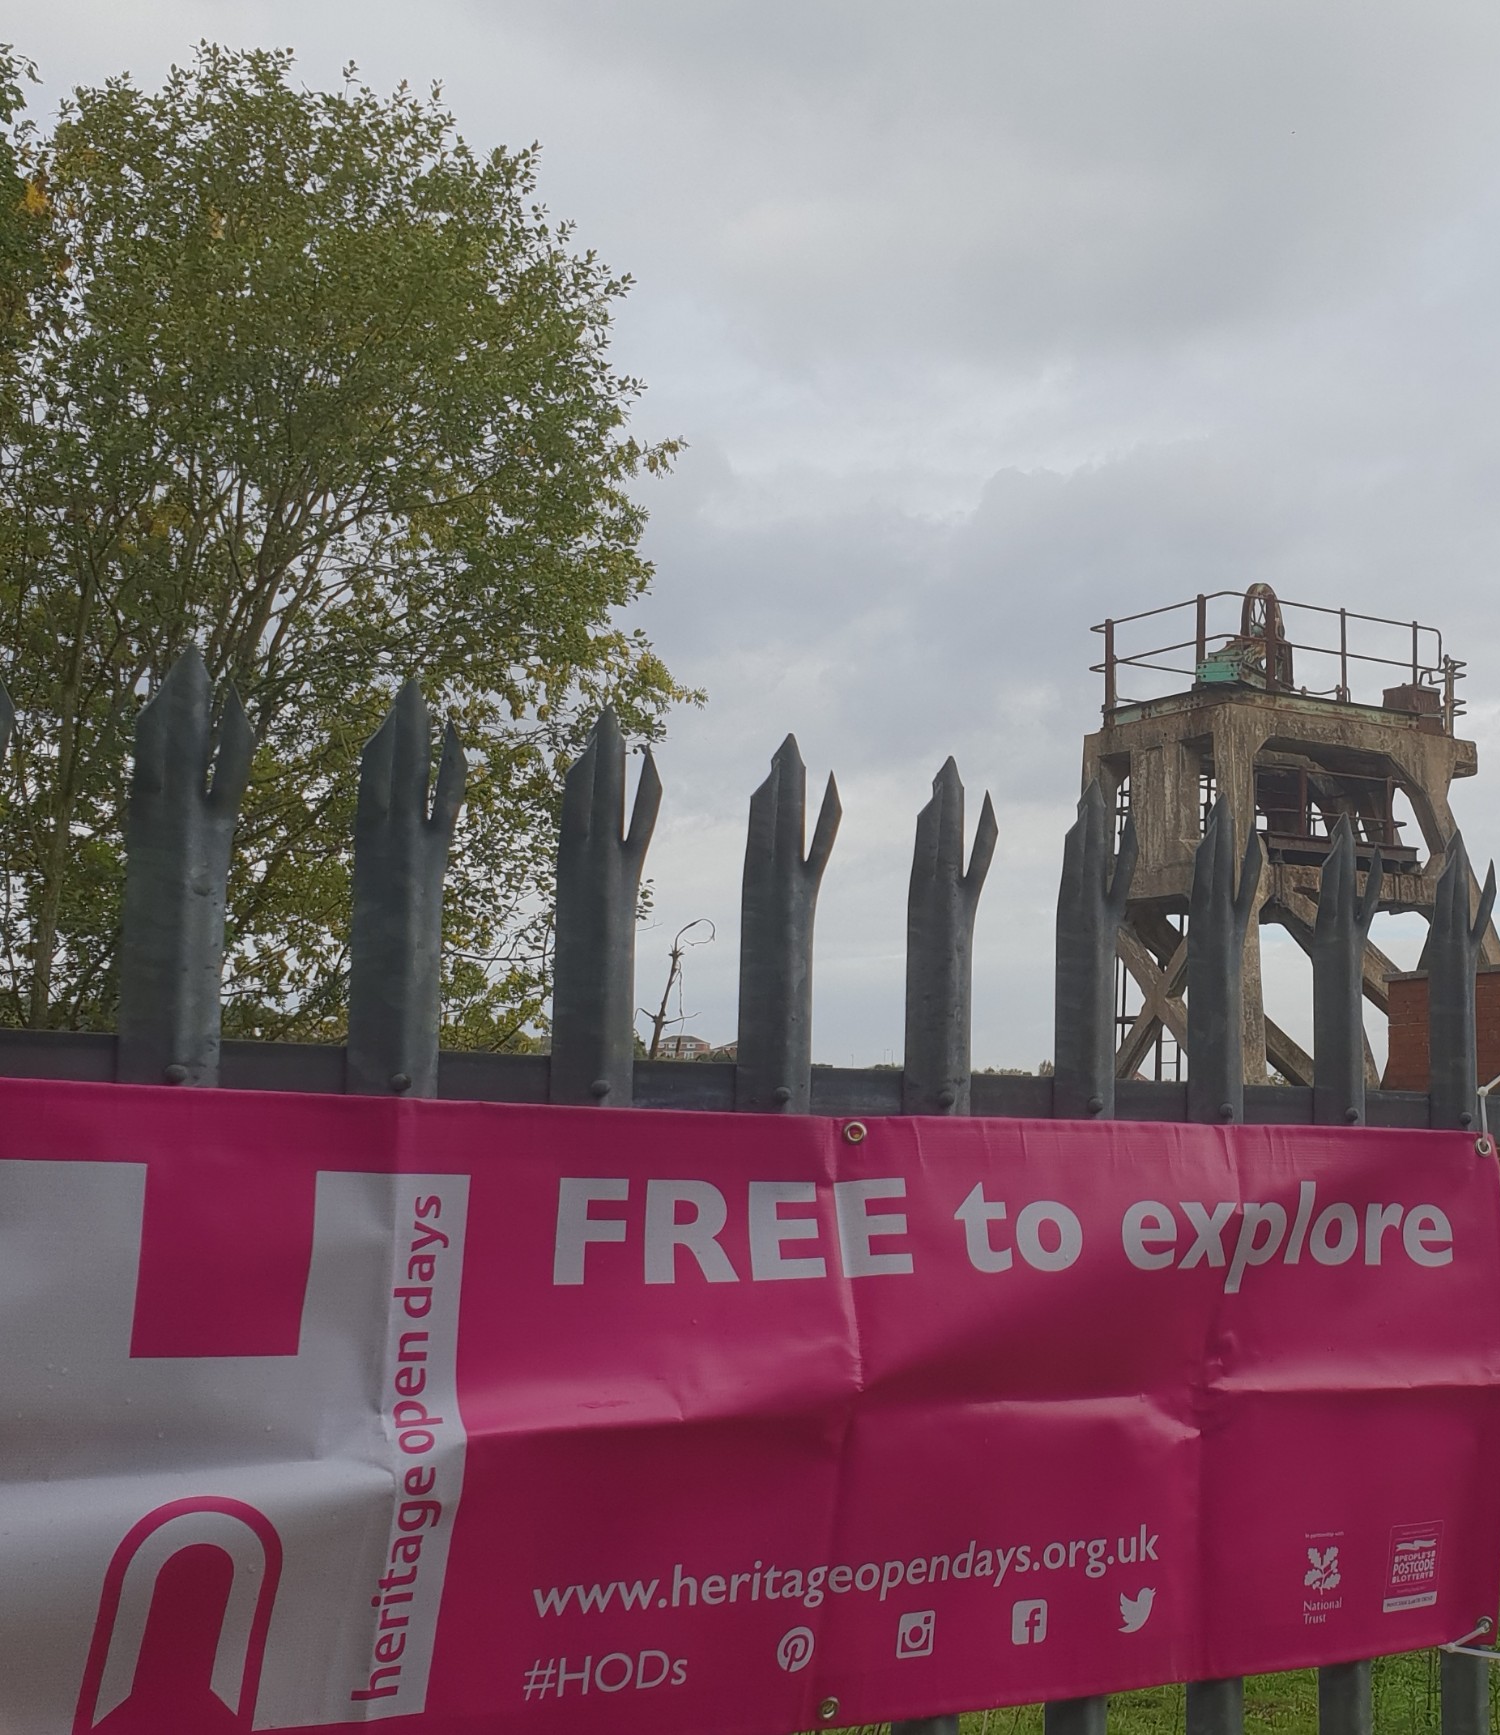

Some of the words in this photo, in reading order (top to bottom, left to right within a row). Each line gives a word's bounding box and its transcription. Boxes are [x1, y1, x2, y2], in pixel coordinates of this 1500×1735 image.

[393, 1193, 449, 1320] days
[553, 1177, 914, 1286] FREE
[954, 1181, 1083, 1274] to
[1121, 1180, 1454, 1294] explore
[394, 1331, 444, 1455] open
[351, 1466, 442, 1701] heritage
[533, 1524, 1159, 1618] www.heritageopendays.org.uk
[1303, 1597, 1342, 1611] National
[1393, 1558, 1435, 1576] POSTCODE
[1303, 1613, 1327, 1625] Trust
[523, 1649, 688, 1701] #HODs
